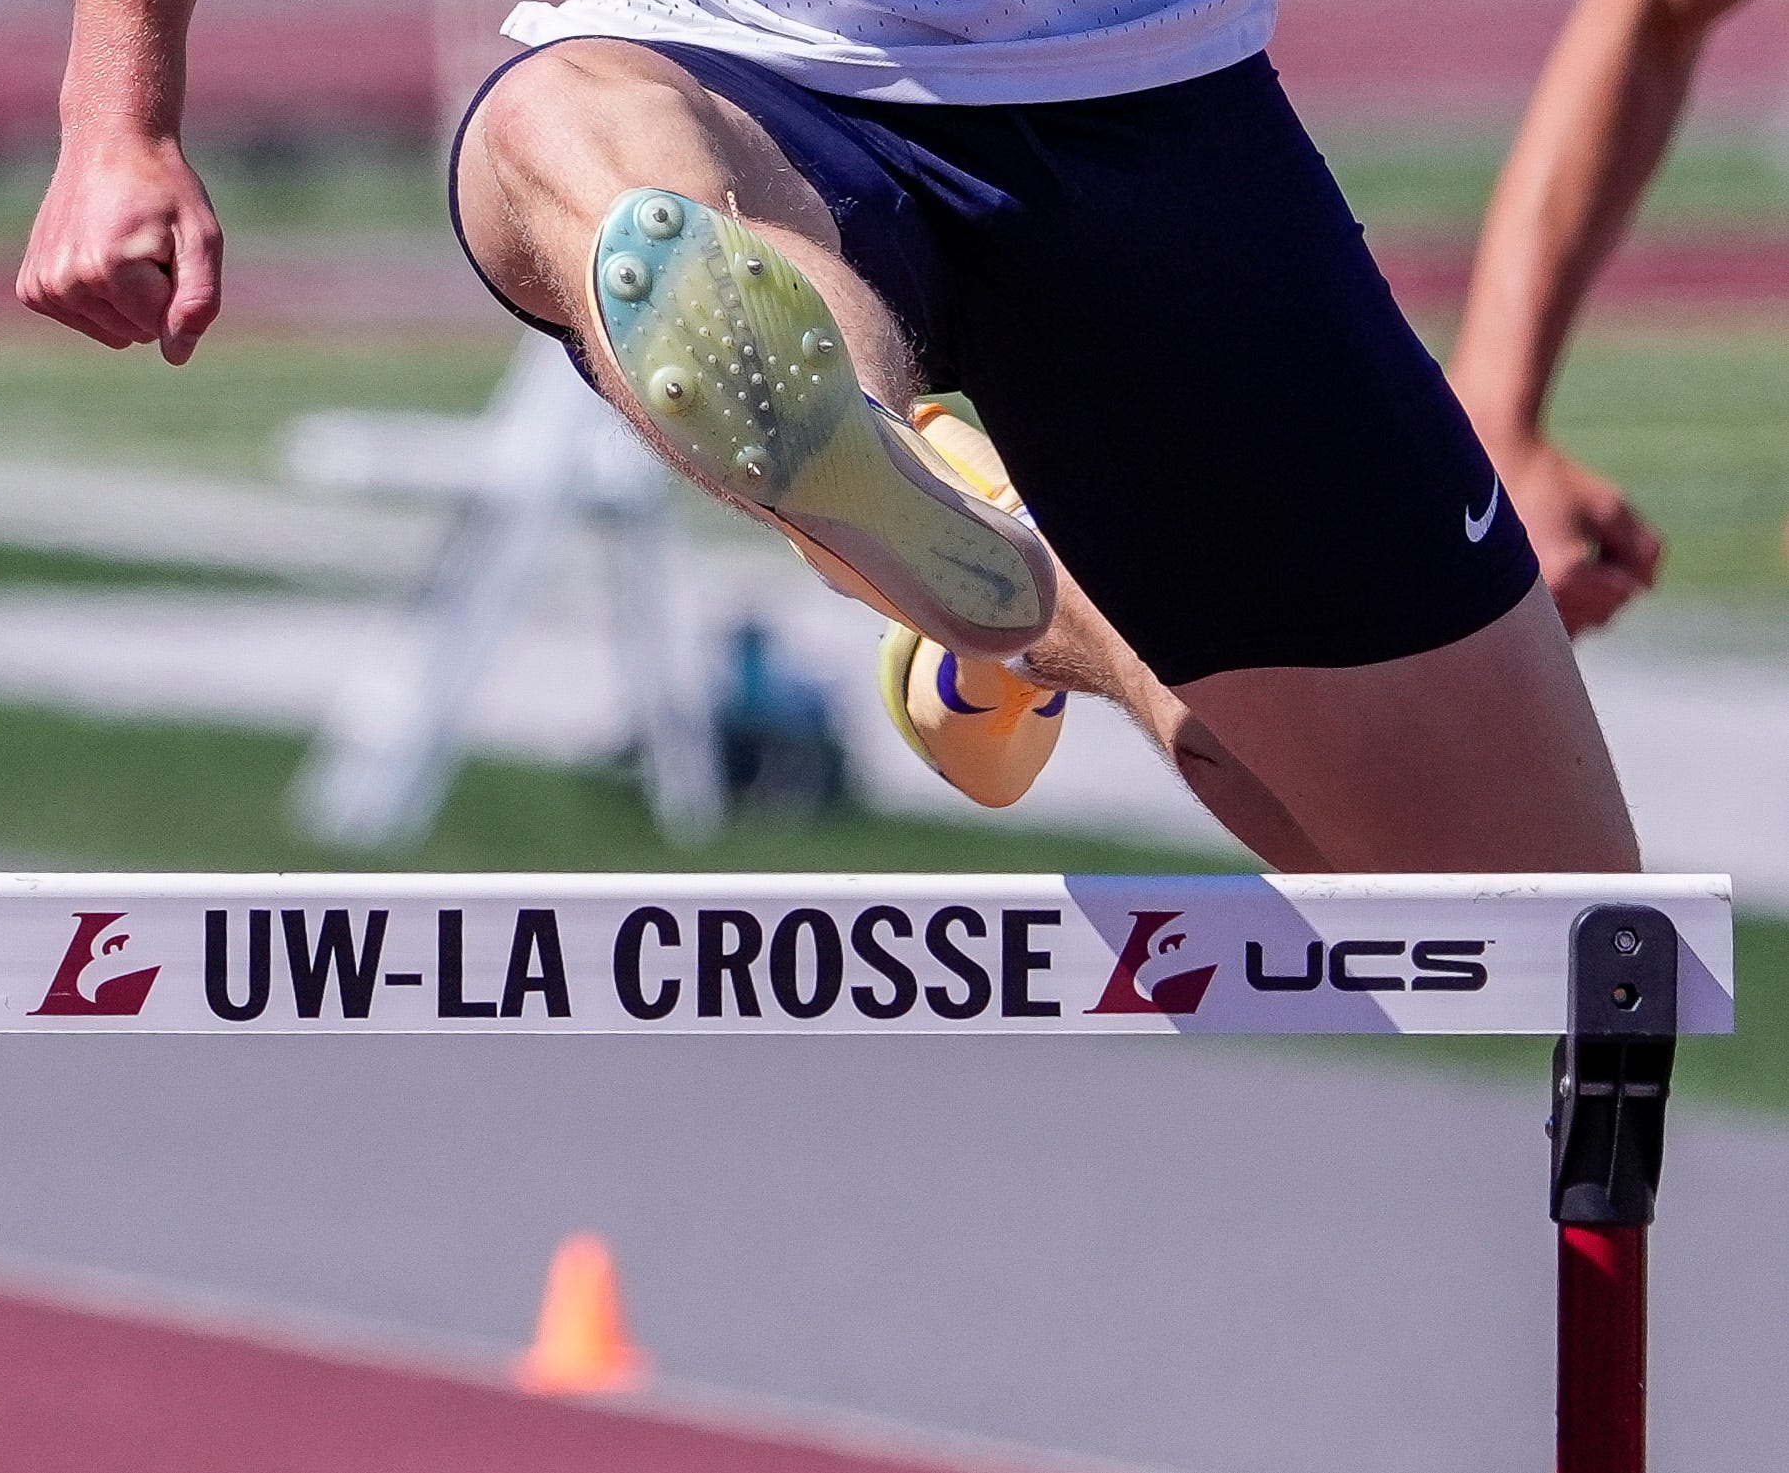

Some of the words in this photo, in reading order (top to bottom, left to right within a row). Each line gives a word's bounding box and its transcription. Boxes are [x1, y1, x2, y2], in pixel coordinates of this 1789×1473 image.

[204, 909, 572, 1022] UW-LA
[613, 905, 1062, 1021] CROSSE
[1245, 940, 1488, 992] UCS
